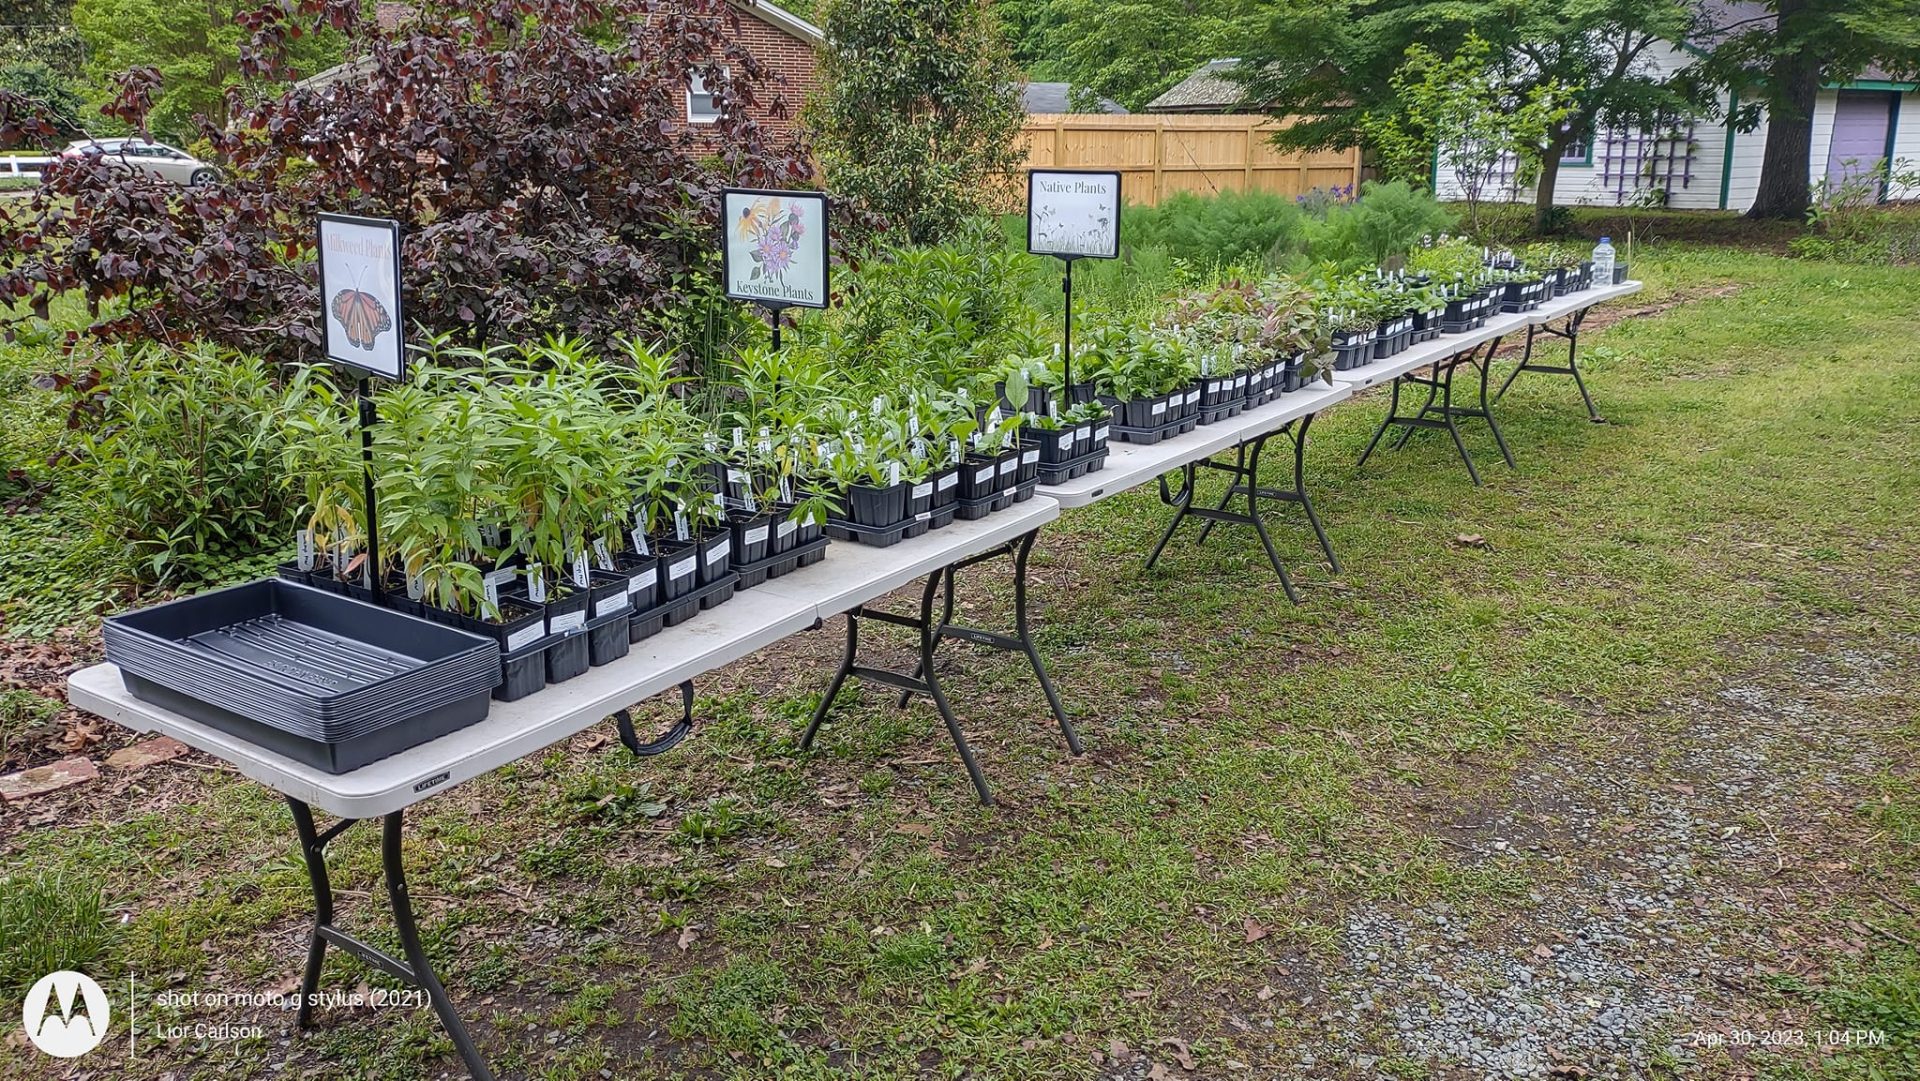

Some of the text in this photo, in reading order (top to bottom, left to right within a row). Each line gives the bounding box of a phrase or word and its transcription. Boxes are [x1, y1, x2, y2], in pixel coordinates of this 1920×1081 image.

[1040, 180, 1107, 195] Native Plants
[326, 232, 392, 260] Milkweed Plants
[736, 280, 814, 301] Keystone Plants
